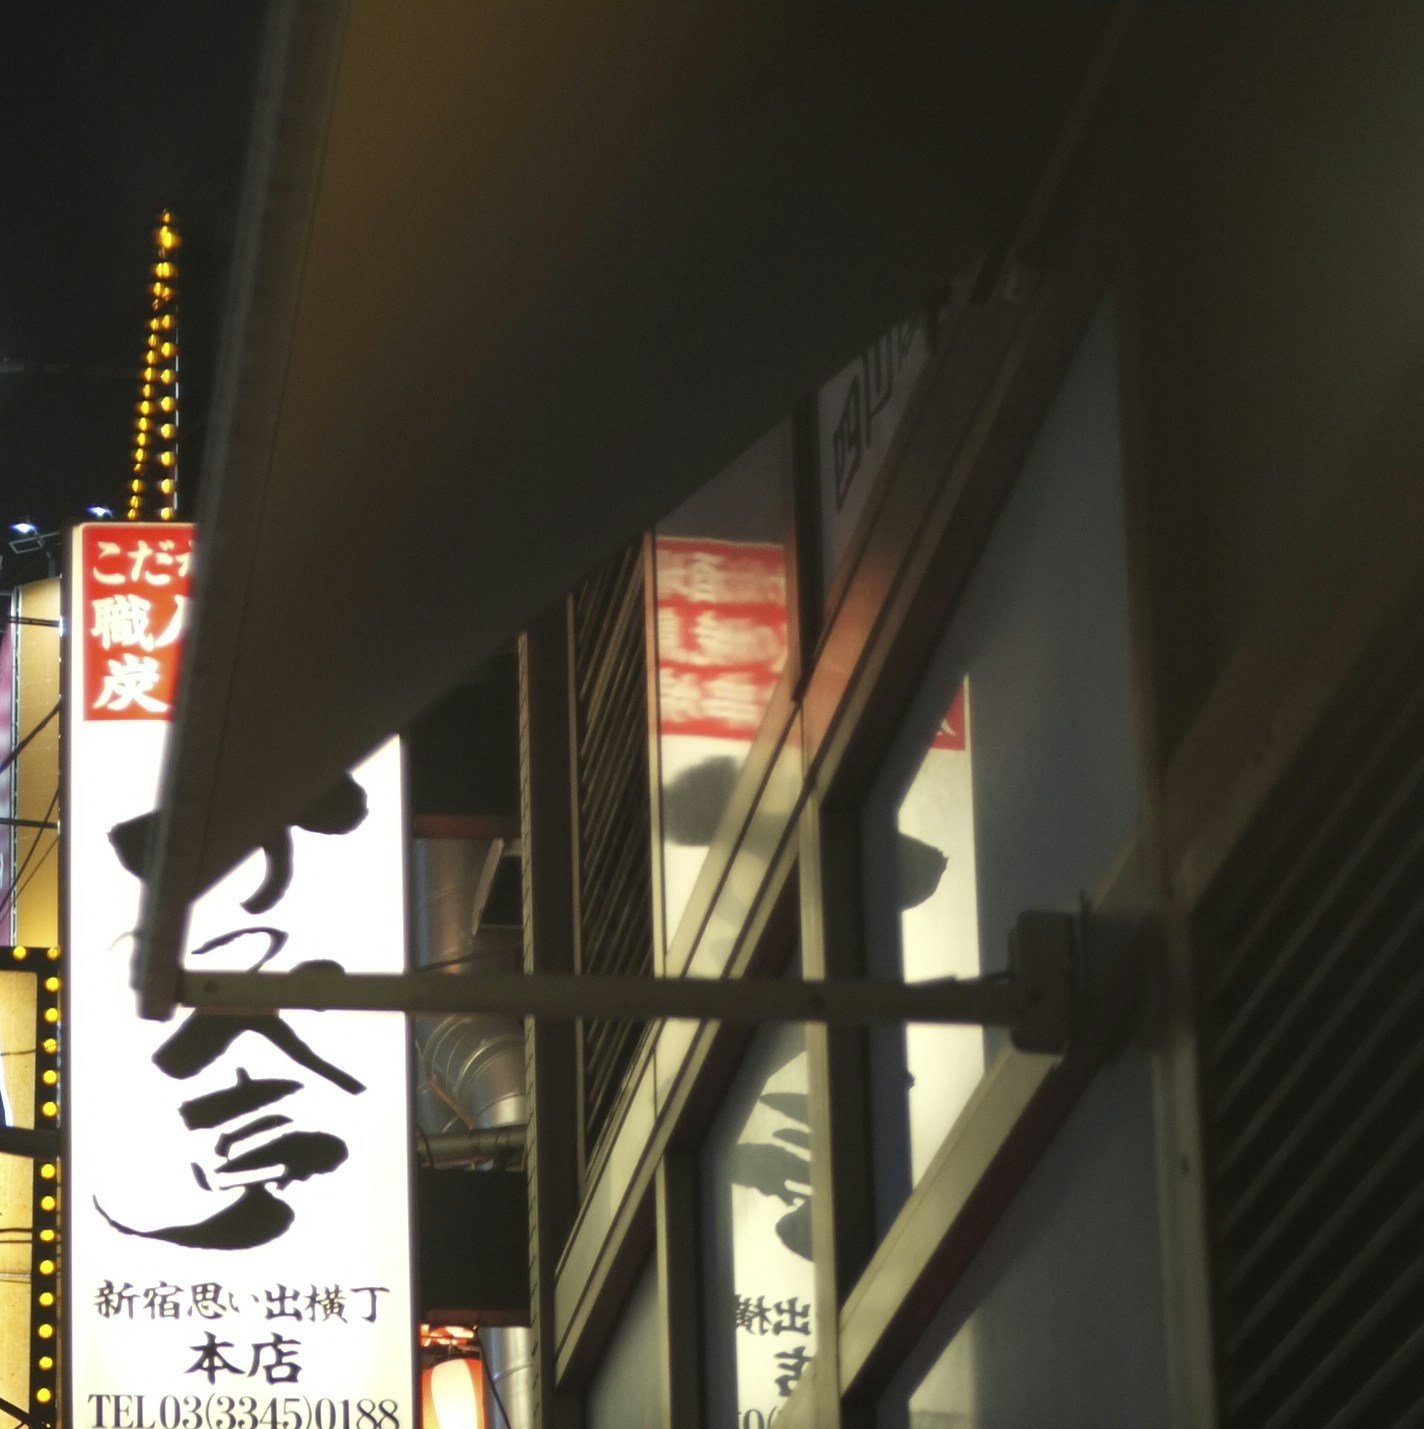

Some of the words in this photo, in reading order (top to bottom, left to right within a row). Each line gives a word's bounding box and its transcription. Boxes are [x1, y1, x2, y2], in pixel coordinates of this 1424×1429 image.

[94, 1280, 390, 1323] 新宿思い出横丁
[183, 1331, 303, 1385] 本店
